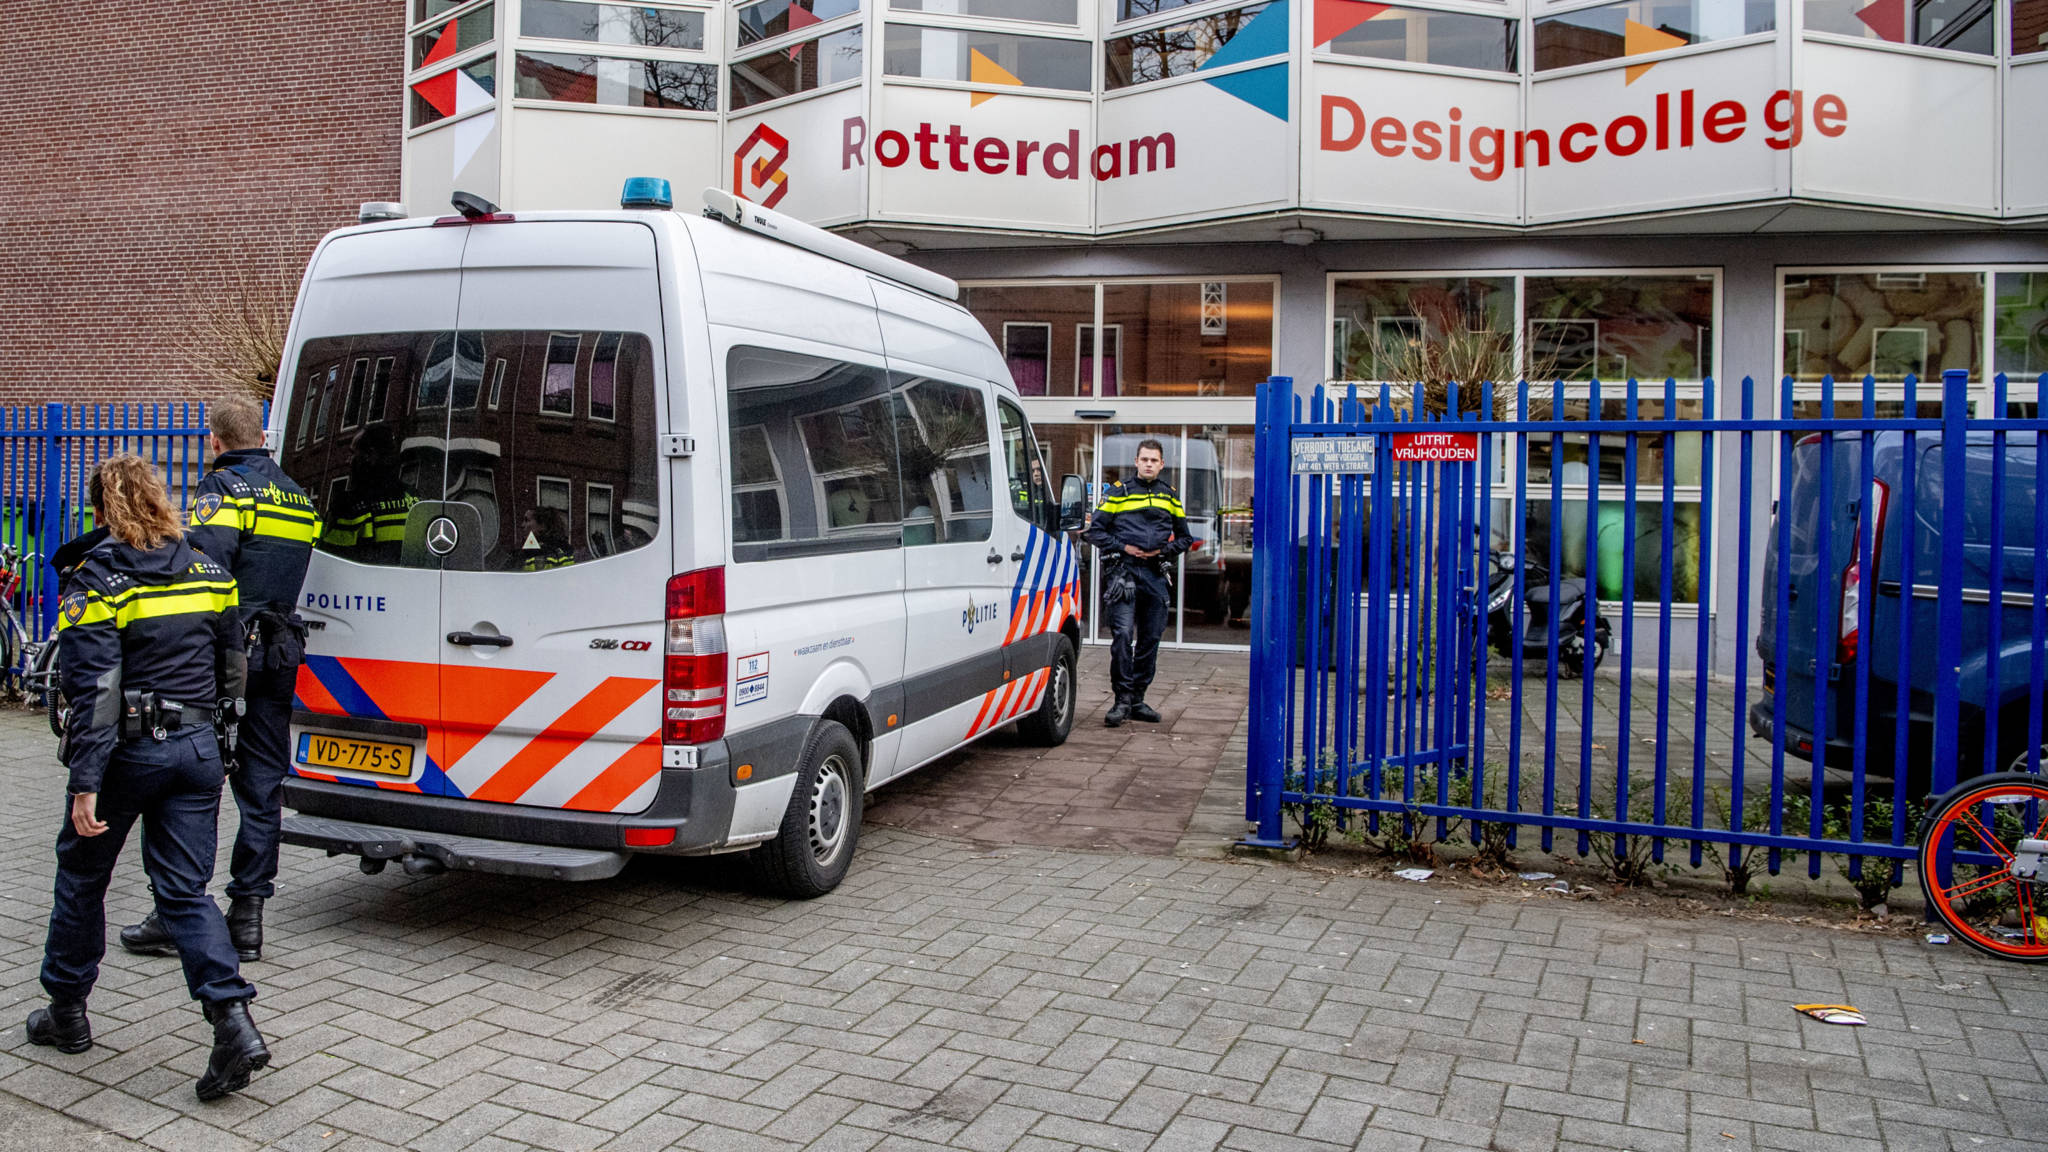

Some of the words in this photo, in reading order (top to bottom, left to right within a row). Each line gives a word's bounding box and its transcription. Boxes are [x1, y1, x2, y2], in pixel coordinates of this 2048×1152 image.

[842, 115, 1176, 182] Rotterdam
[1294, 440, 1335, 457] VERBODEN
[1337, 439, 1373, 454] TOEGANG
[1414, 434, 1454, 446] UITRIT
[1395, 447, 1475, 459] VRIJHOUDEN
[263, 485, 310, 506] POLITIE
[306, 593, 386, 612] POLITIE
[962, 602, 997, 634] POLITIE
[620, 640, 652, 652] CDI
[748, 659, 758, 670] 112
[316, 739, 402, 770] VD-775-S
